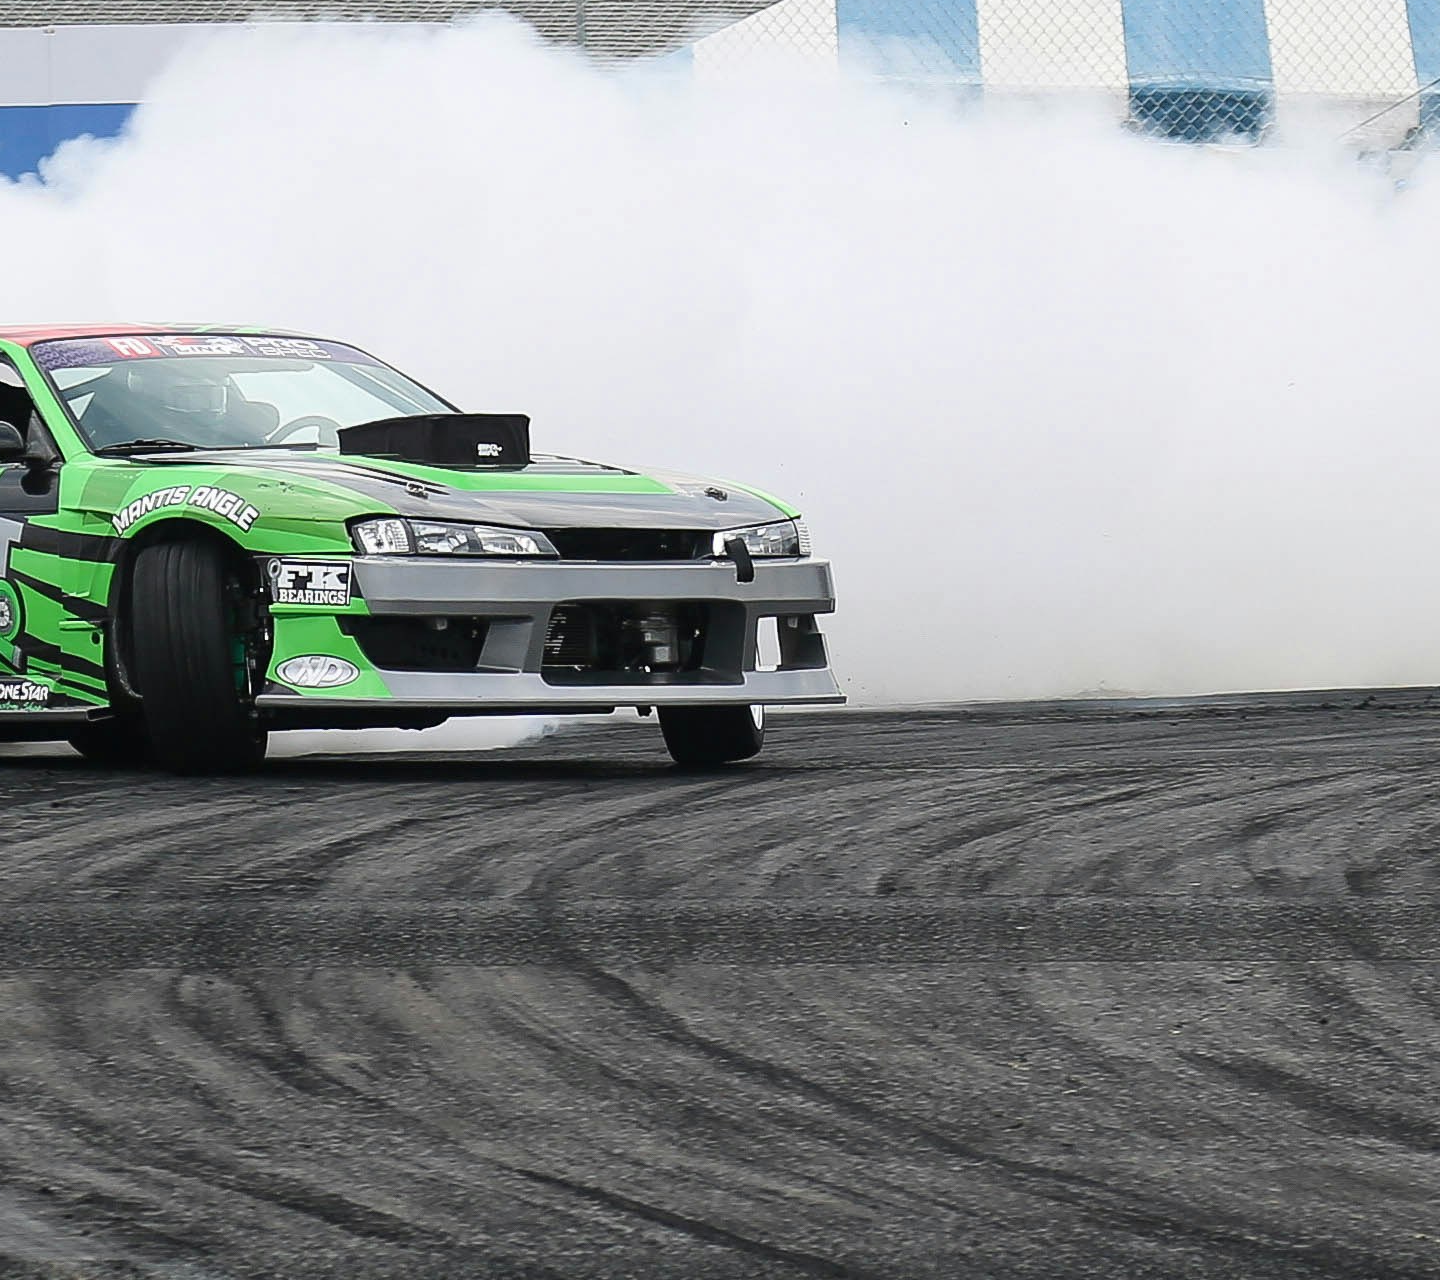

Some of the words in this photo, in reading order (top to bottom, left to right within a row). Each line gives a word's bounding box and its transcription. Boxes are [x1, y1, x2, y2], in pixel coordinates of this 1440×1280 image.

[247, 336, 319, 350] PRO
[259, 347, 332, 360] SPEC
[111, 486, 192, 535] MANTIS
[188, 486, 260, 532] ANGLE
[278, 565, 348, 590] FK
[279, 589, 346, 605] BEARINGS
